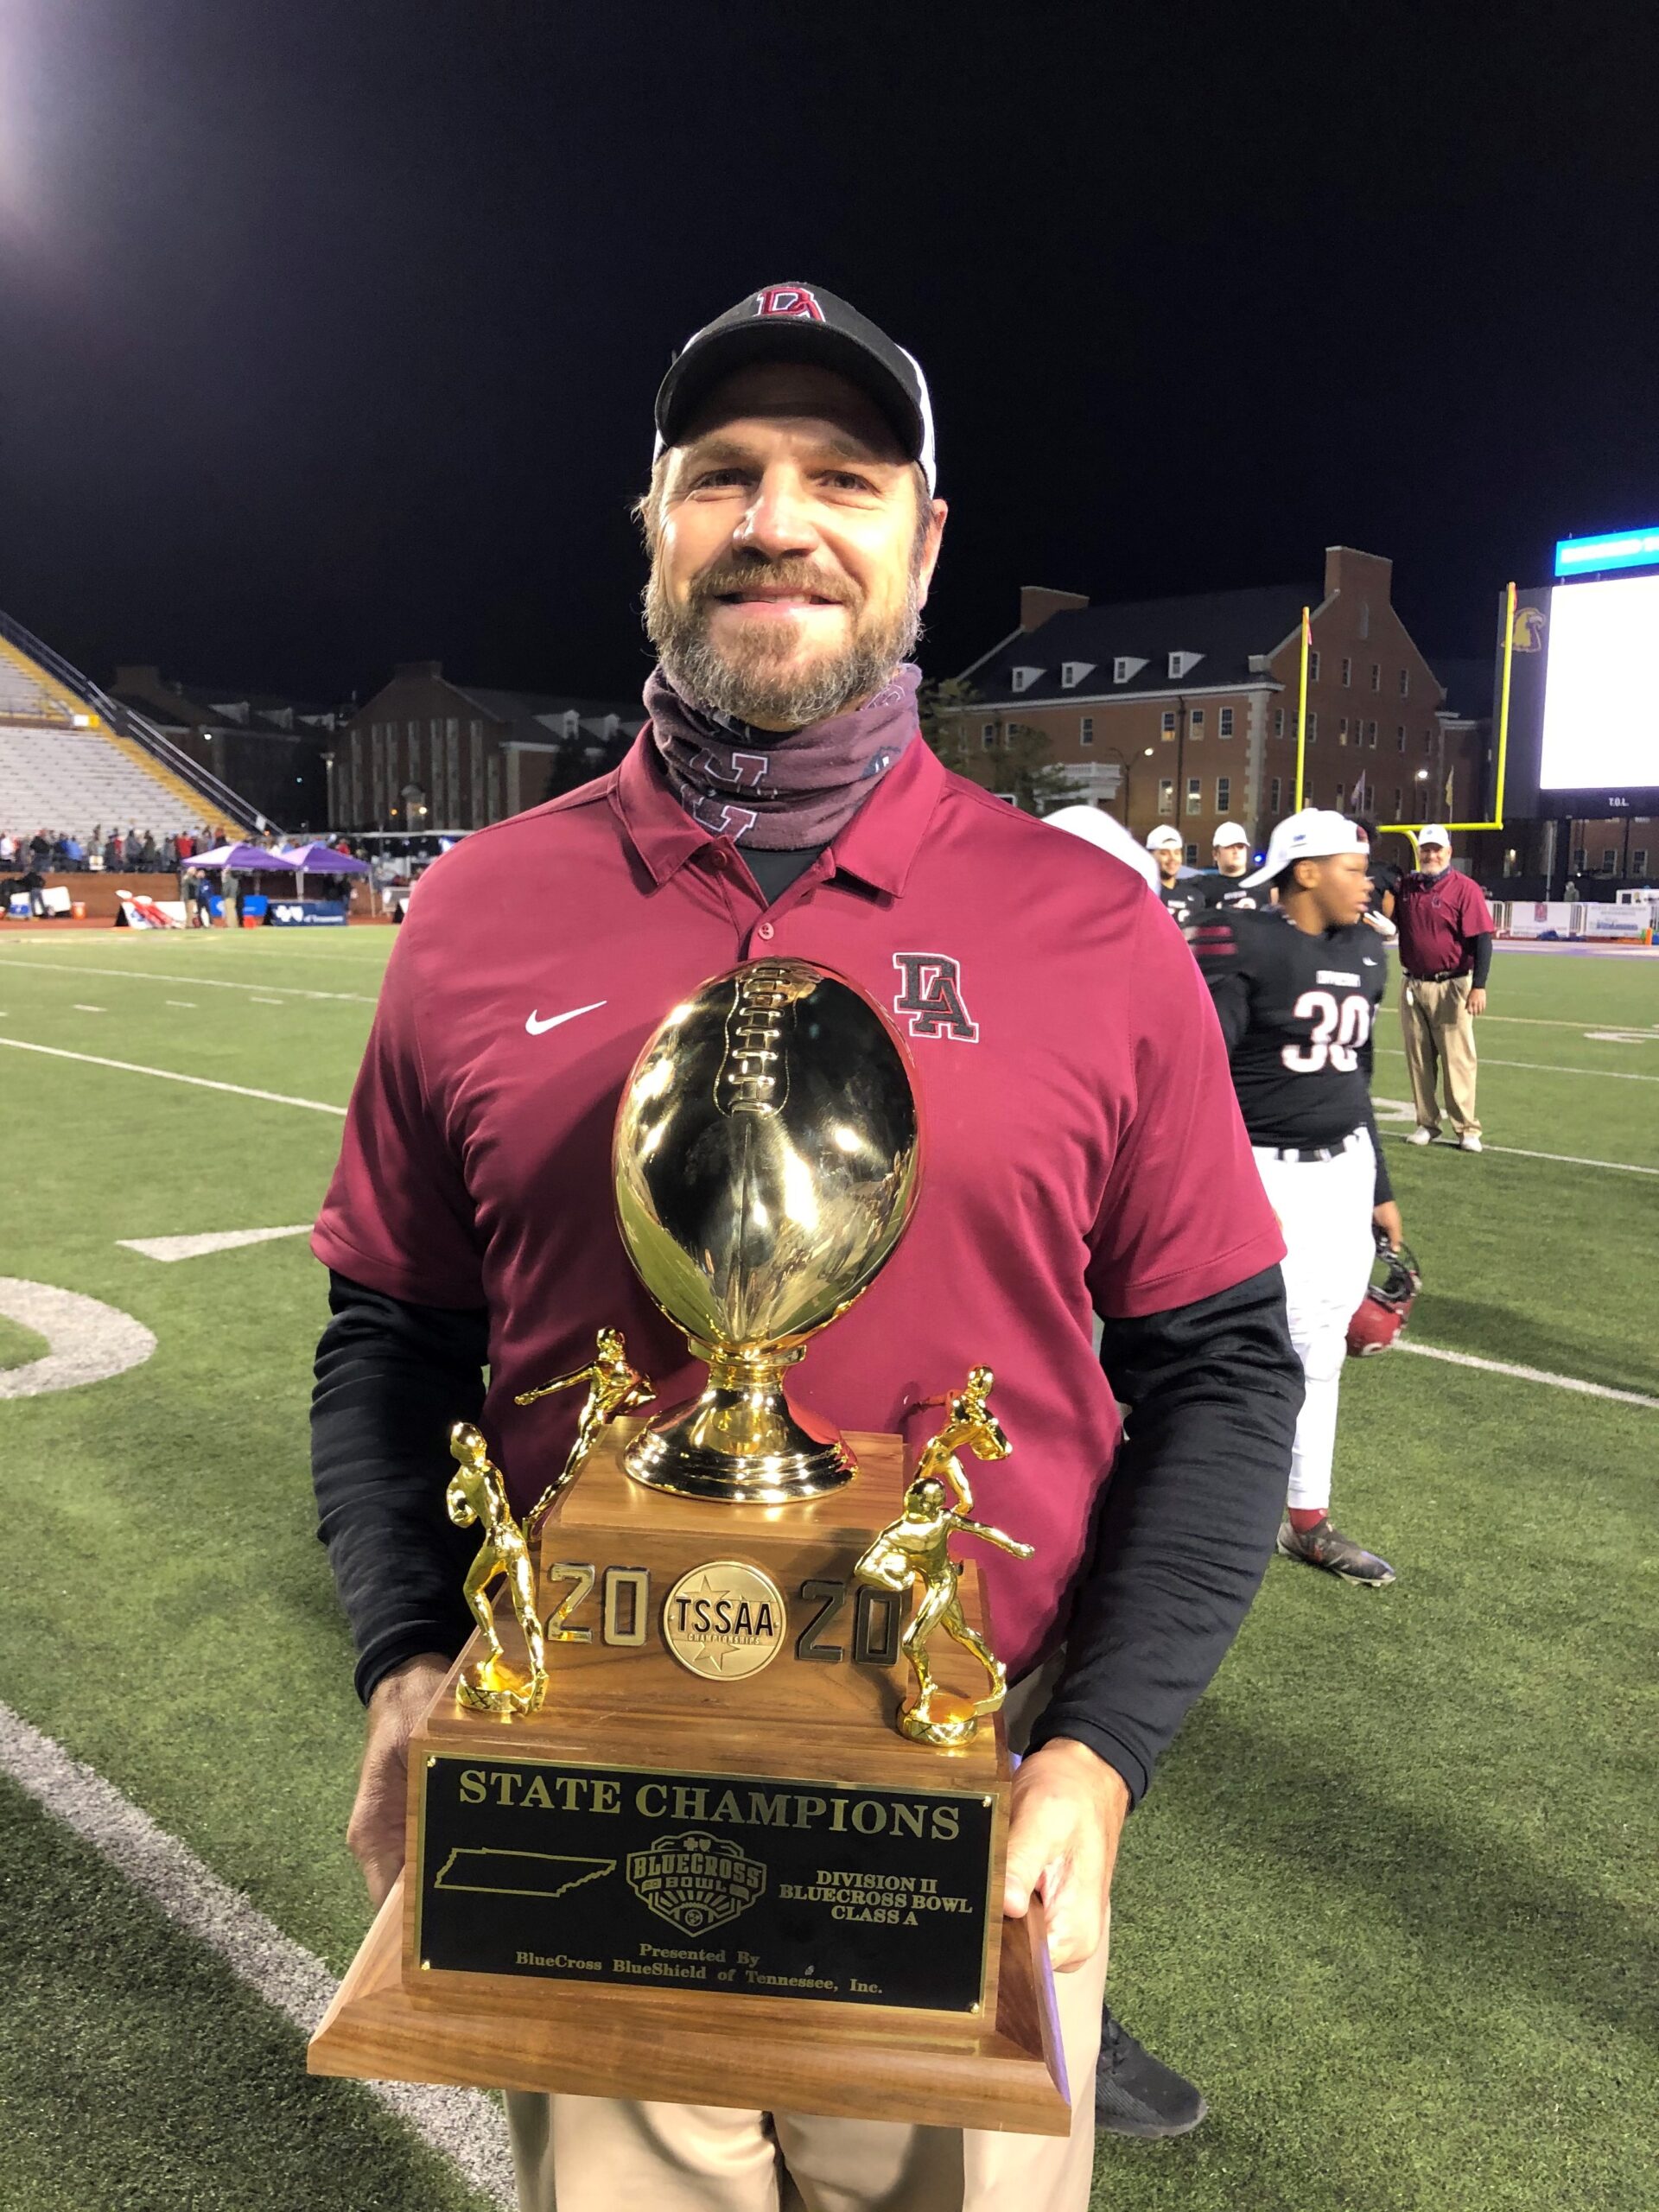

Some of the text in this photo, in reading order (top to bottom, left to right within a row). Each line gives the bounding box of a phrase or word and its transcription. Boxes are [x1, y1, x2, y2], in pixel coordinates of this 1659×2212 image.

[893, 952, 979, 1044] DA
[1281, 989, 1370, 1073] 30
[546, 1562, 650, 1647] 20
[675, 1597, 774, 1637] TSSAA
[796, 1579, 902, 1666] 20
[688, 1633, 760, 1645] CHAMPIONSHIPS
[459, 1770, 960, 1840] STATE CHAMPIONS
[633, 1853, 761, 1889] BLUECROSS
[665, 1876, 727, 1893] BOWL
[816, 1870, 938, 1894] DIVISION II
[779, 1884, 973, 1914] BLUECROSS BOWL
[830, 1904, 918, 1926] CLASS A
[516, 1951, 884, 1994] BlueCross BlueShield of Tennessee, Inc.
[639, 1942, 761, 1968] Presented By
